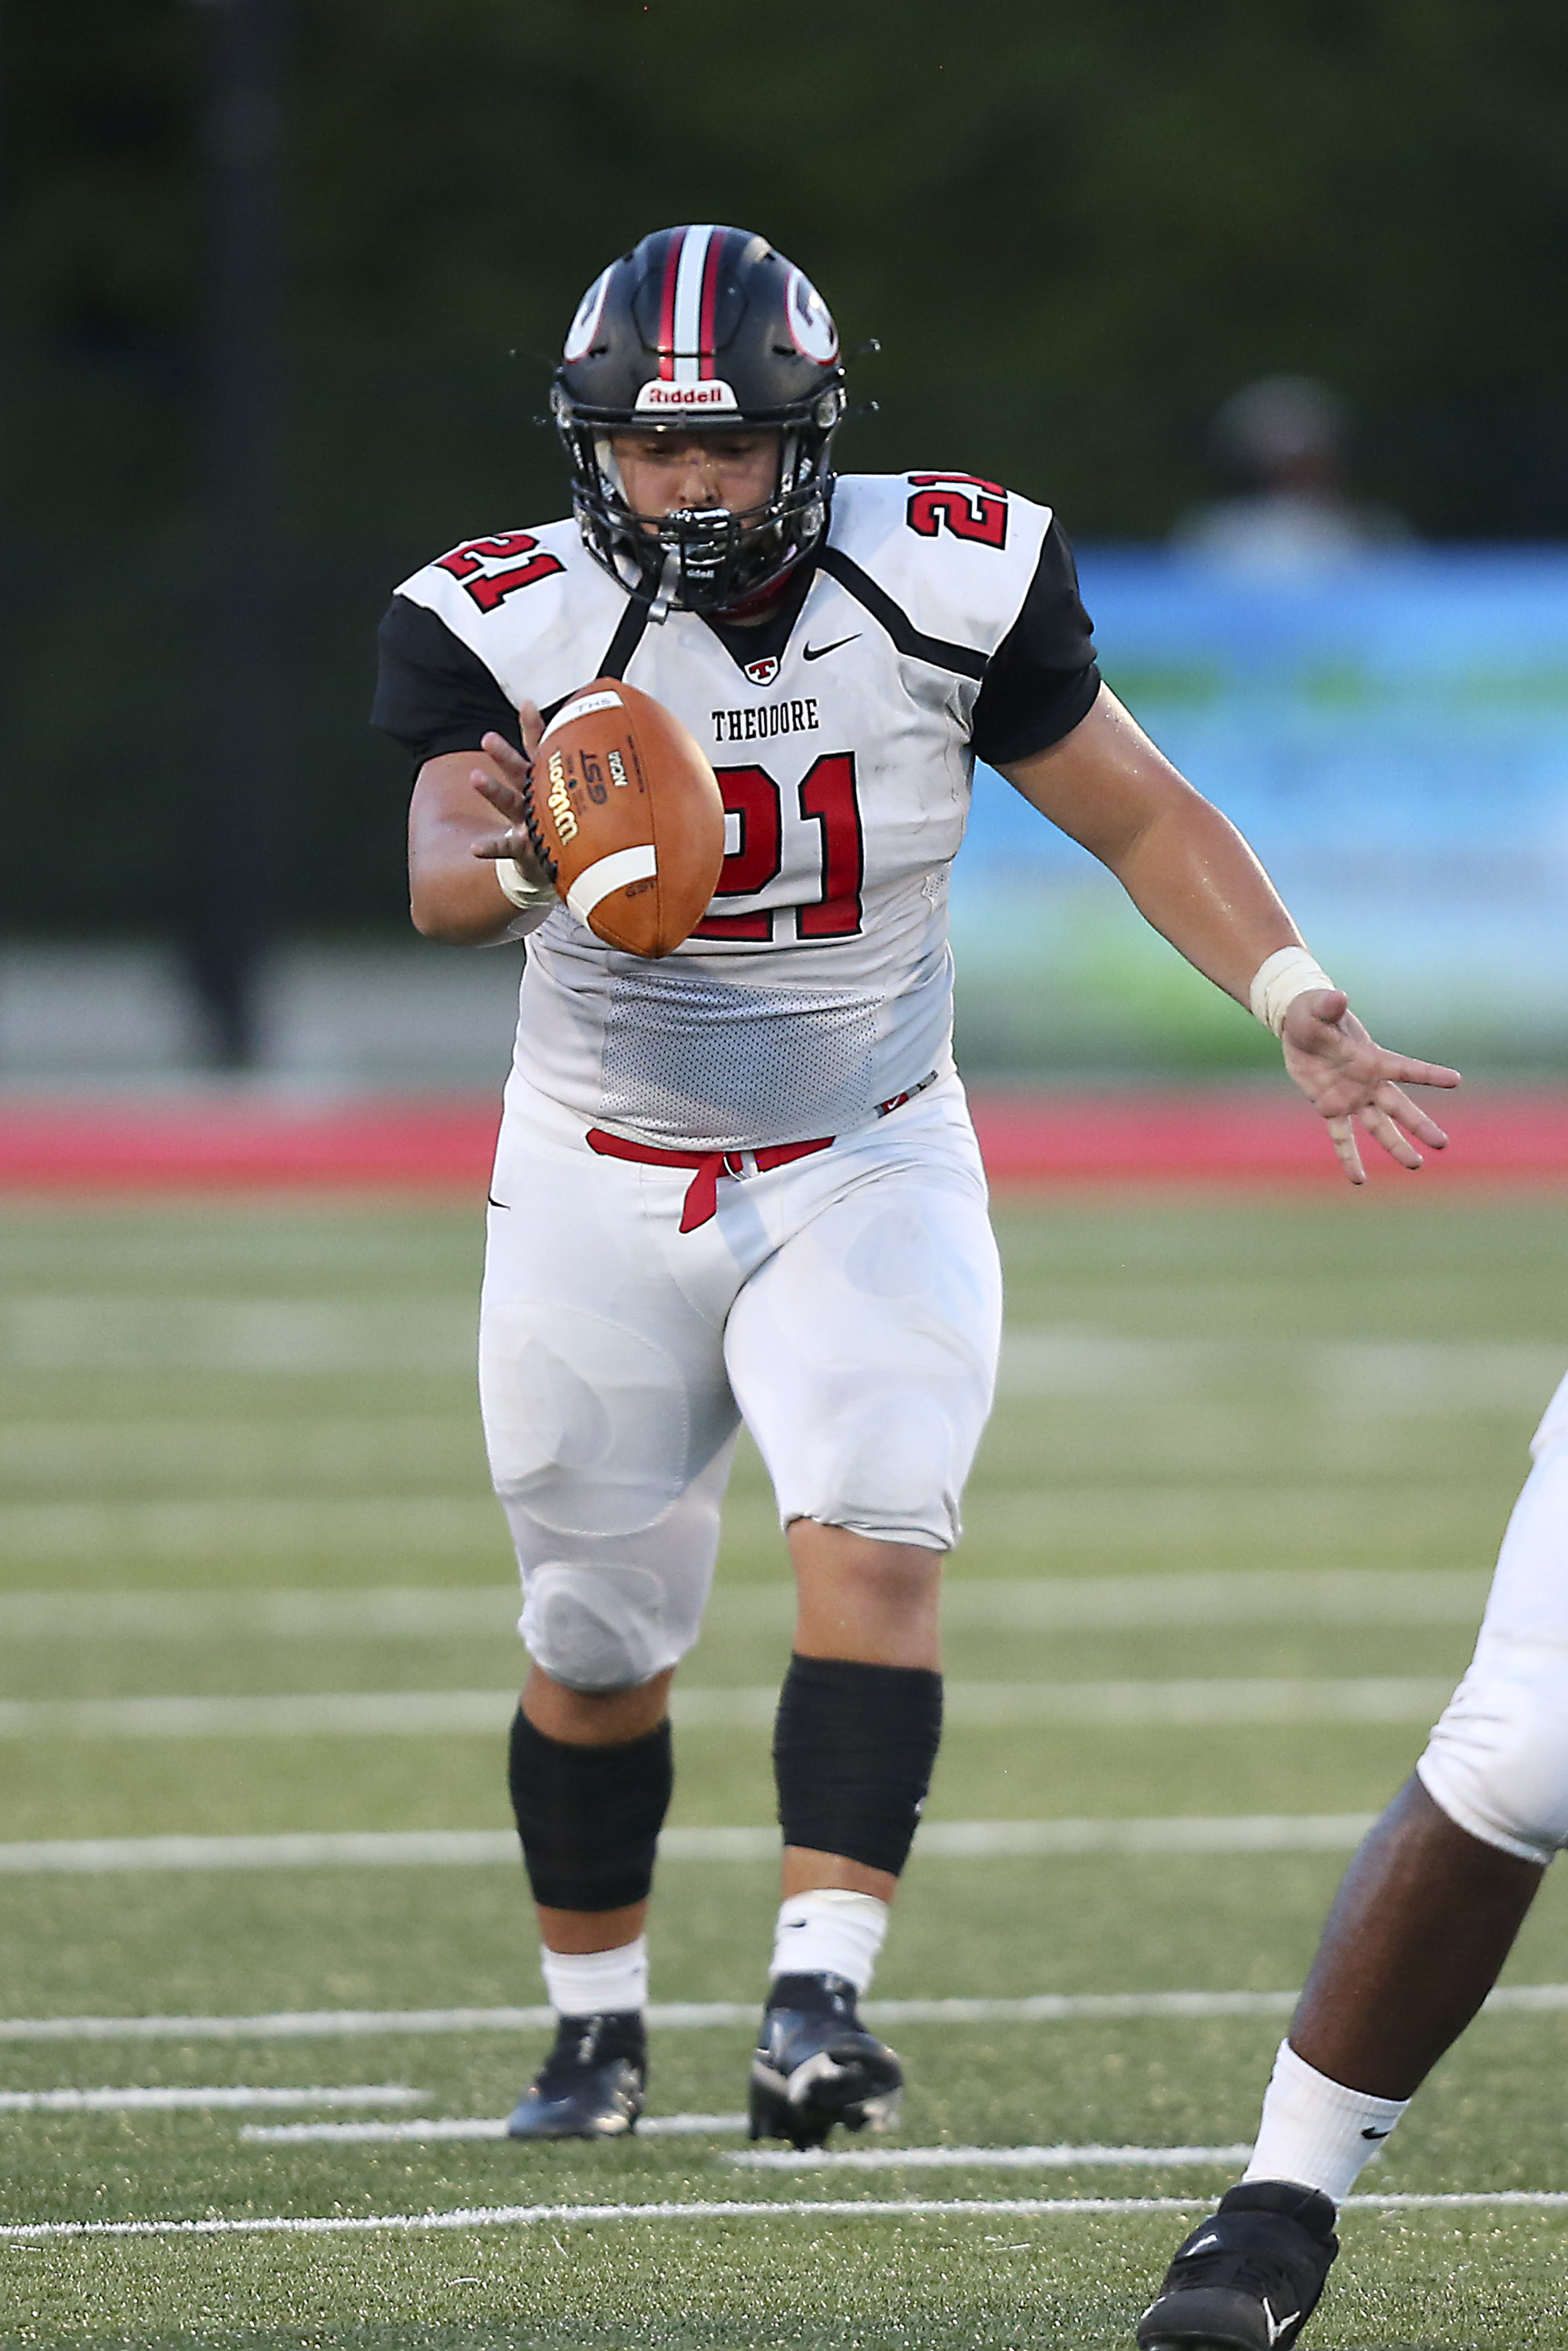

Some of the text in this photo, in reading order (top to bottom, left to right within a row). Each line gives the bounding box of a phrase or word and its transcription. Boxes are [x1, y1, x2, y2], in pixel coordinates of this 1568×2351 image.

[649, 389, 722, 403] Riddell
[434, 533, 567, 615] 21
[749, 660, 775, 680] T
[712, 698, 819, 742] THEODORE
[580, 749, 608, 805] GST
[608, 749, 628, 787] NCAA
[687, 751, 863, 941] 21
